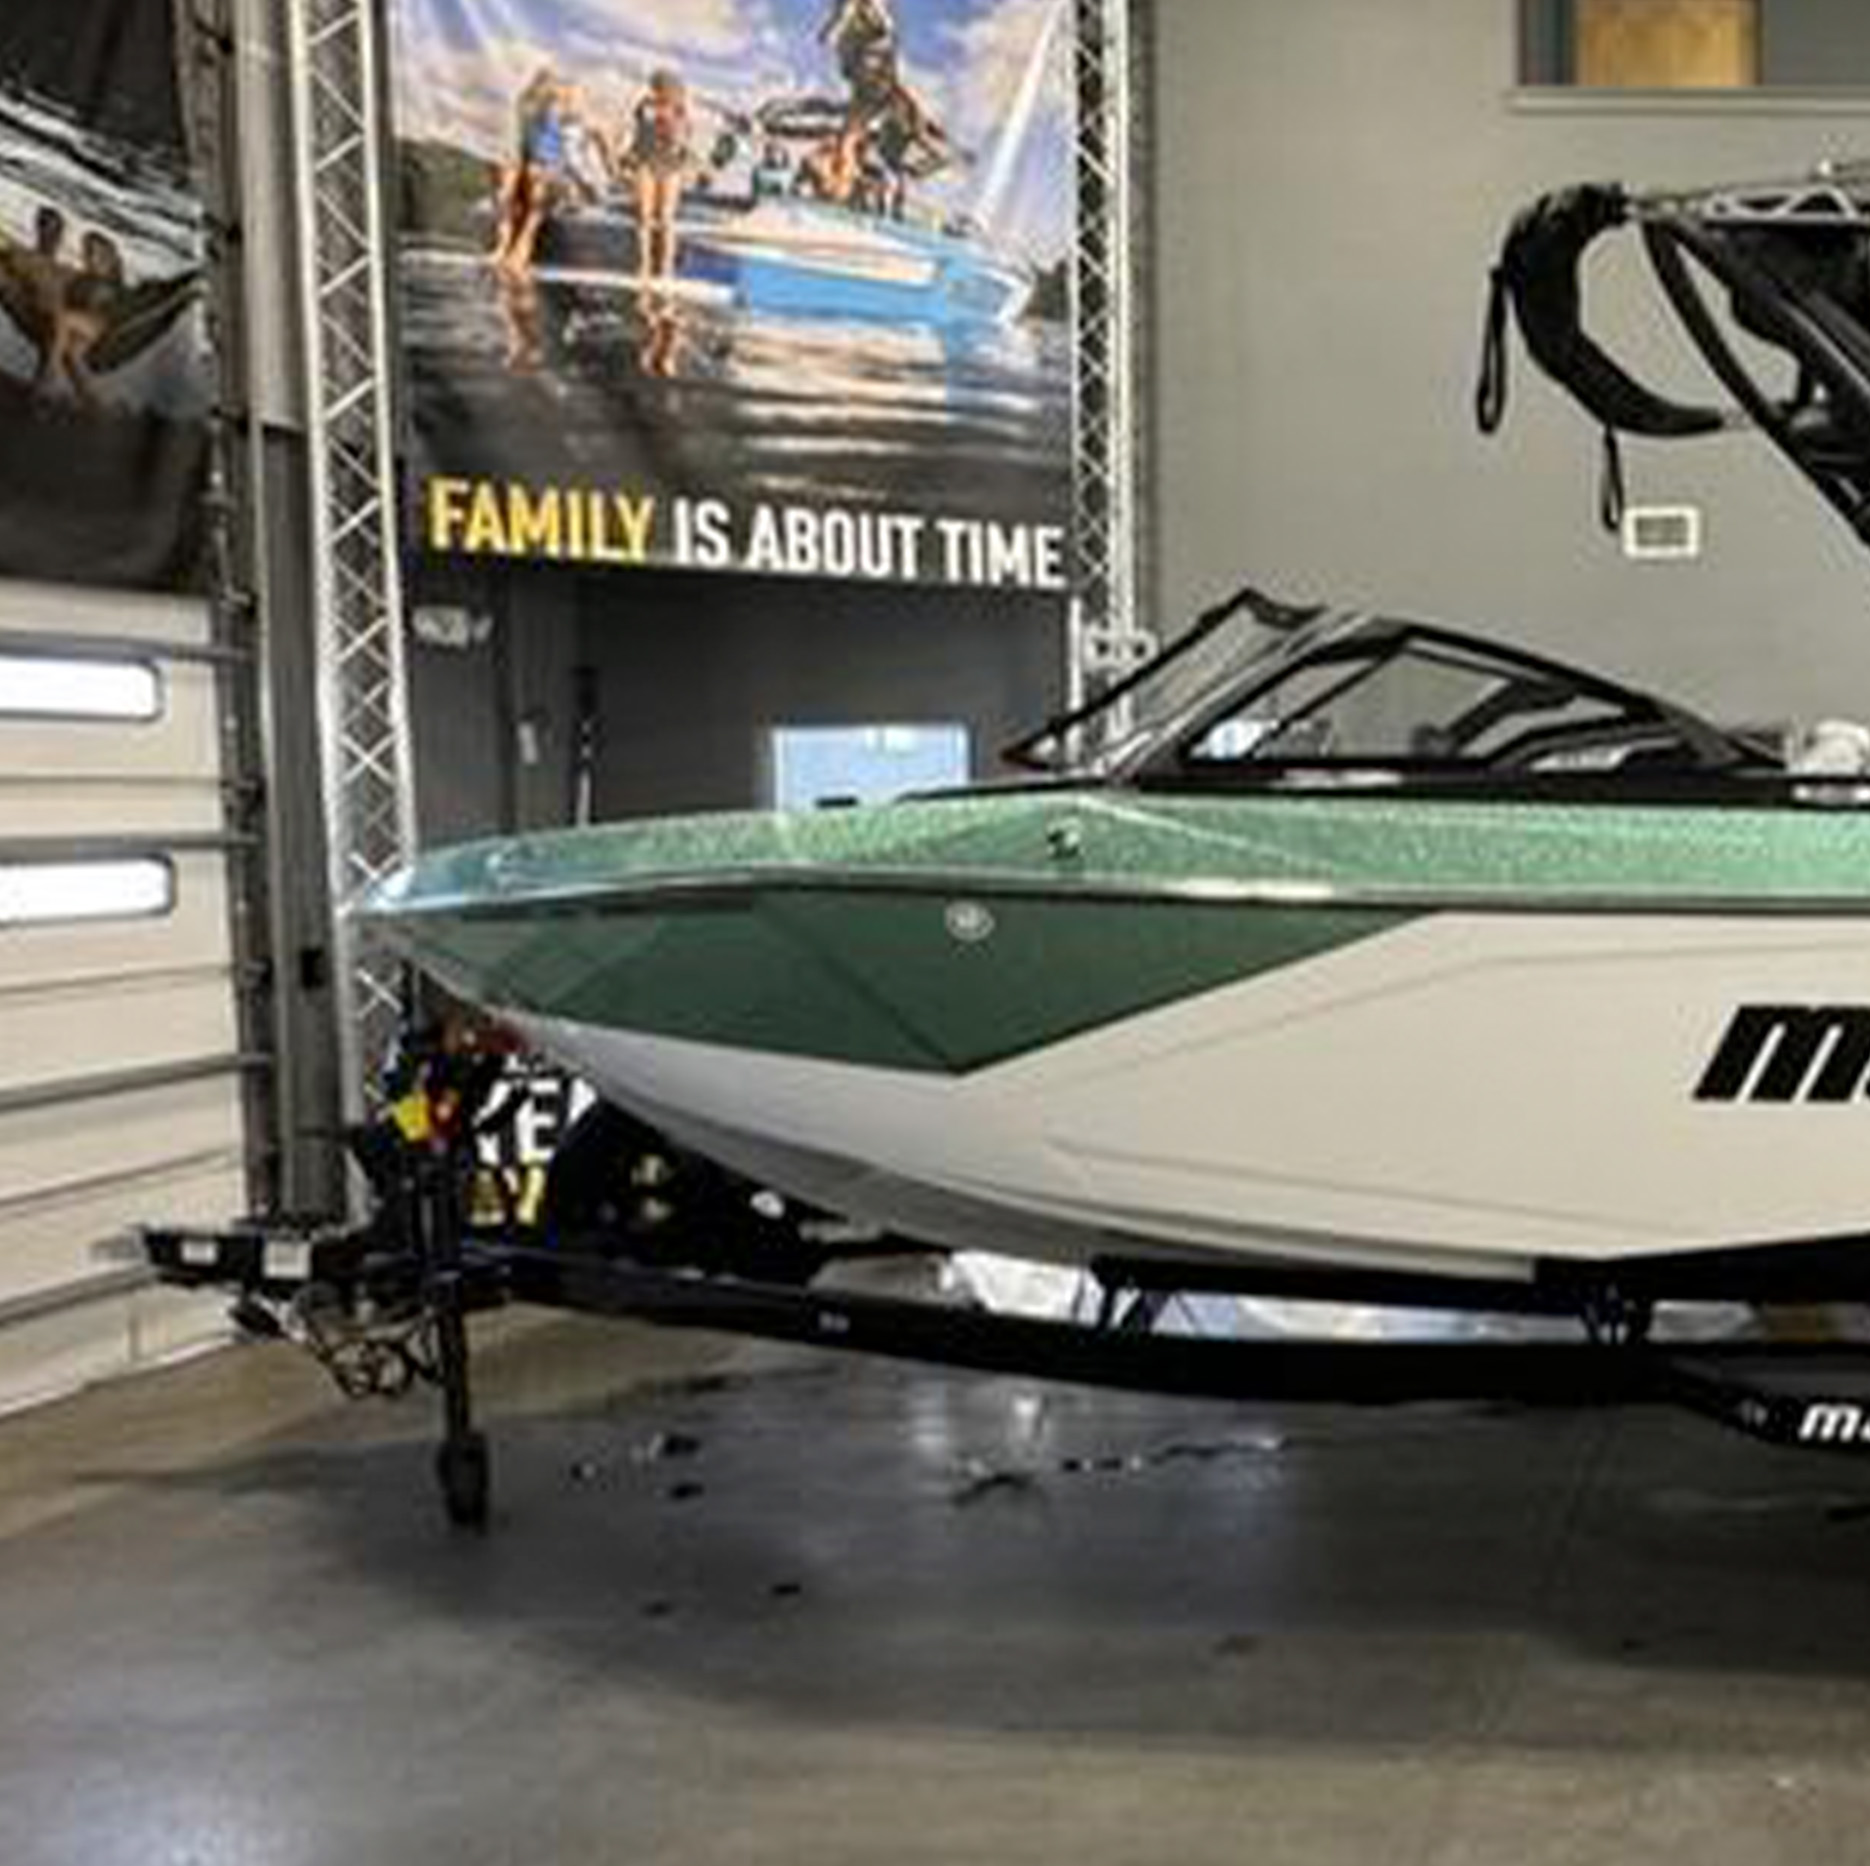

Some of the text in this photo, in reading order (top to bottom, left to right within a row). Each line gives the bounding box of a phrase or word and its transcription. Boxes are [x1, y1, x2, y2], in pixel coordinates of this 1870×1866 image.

[427, 476, 1068, 589] FAMILY IS ABOUT TIME
